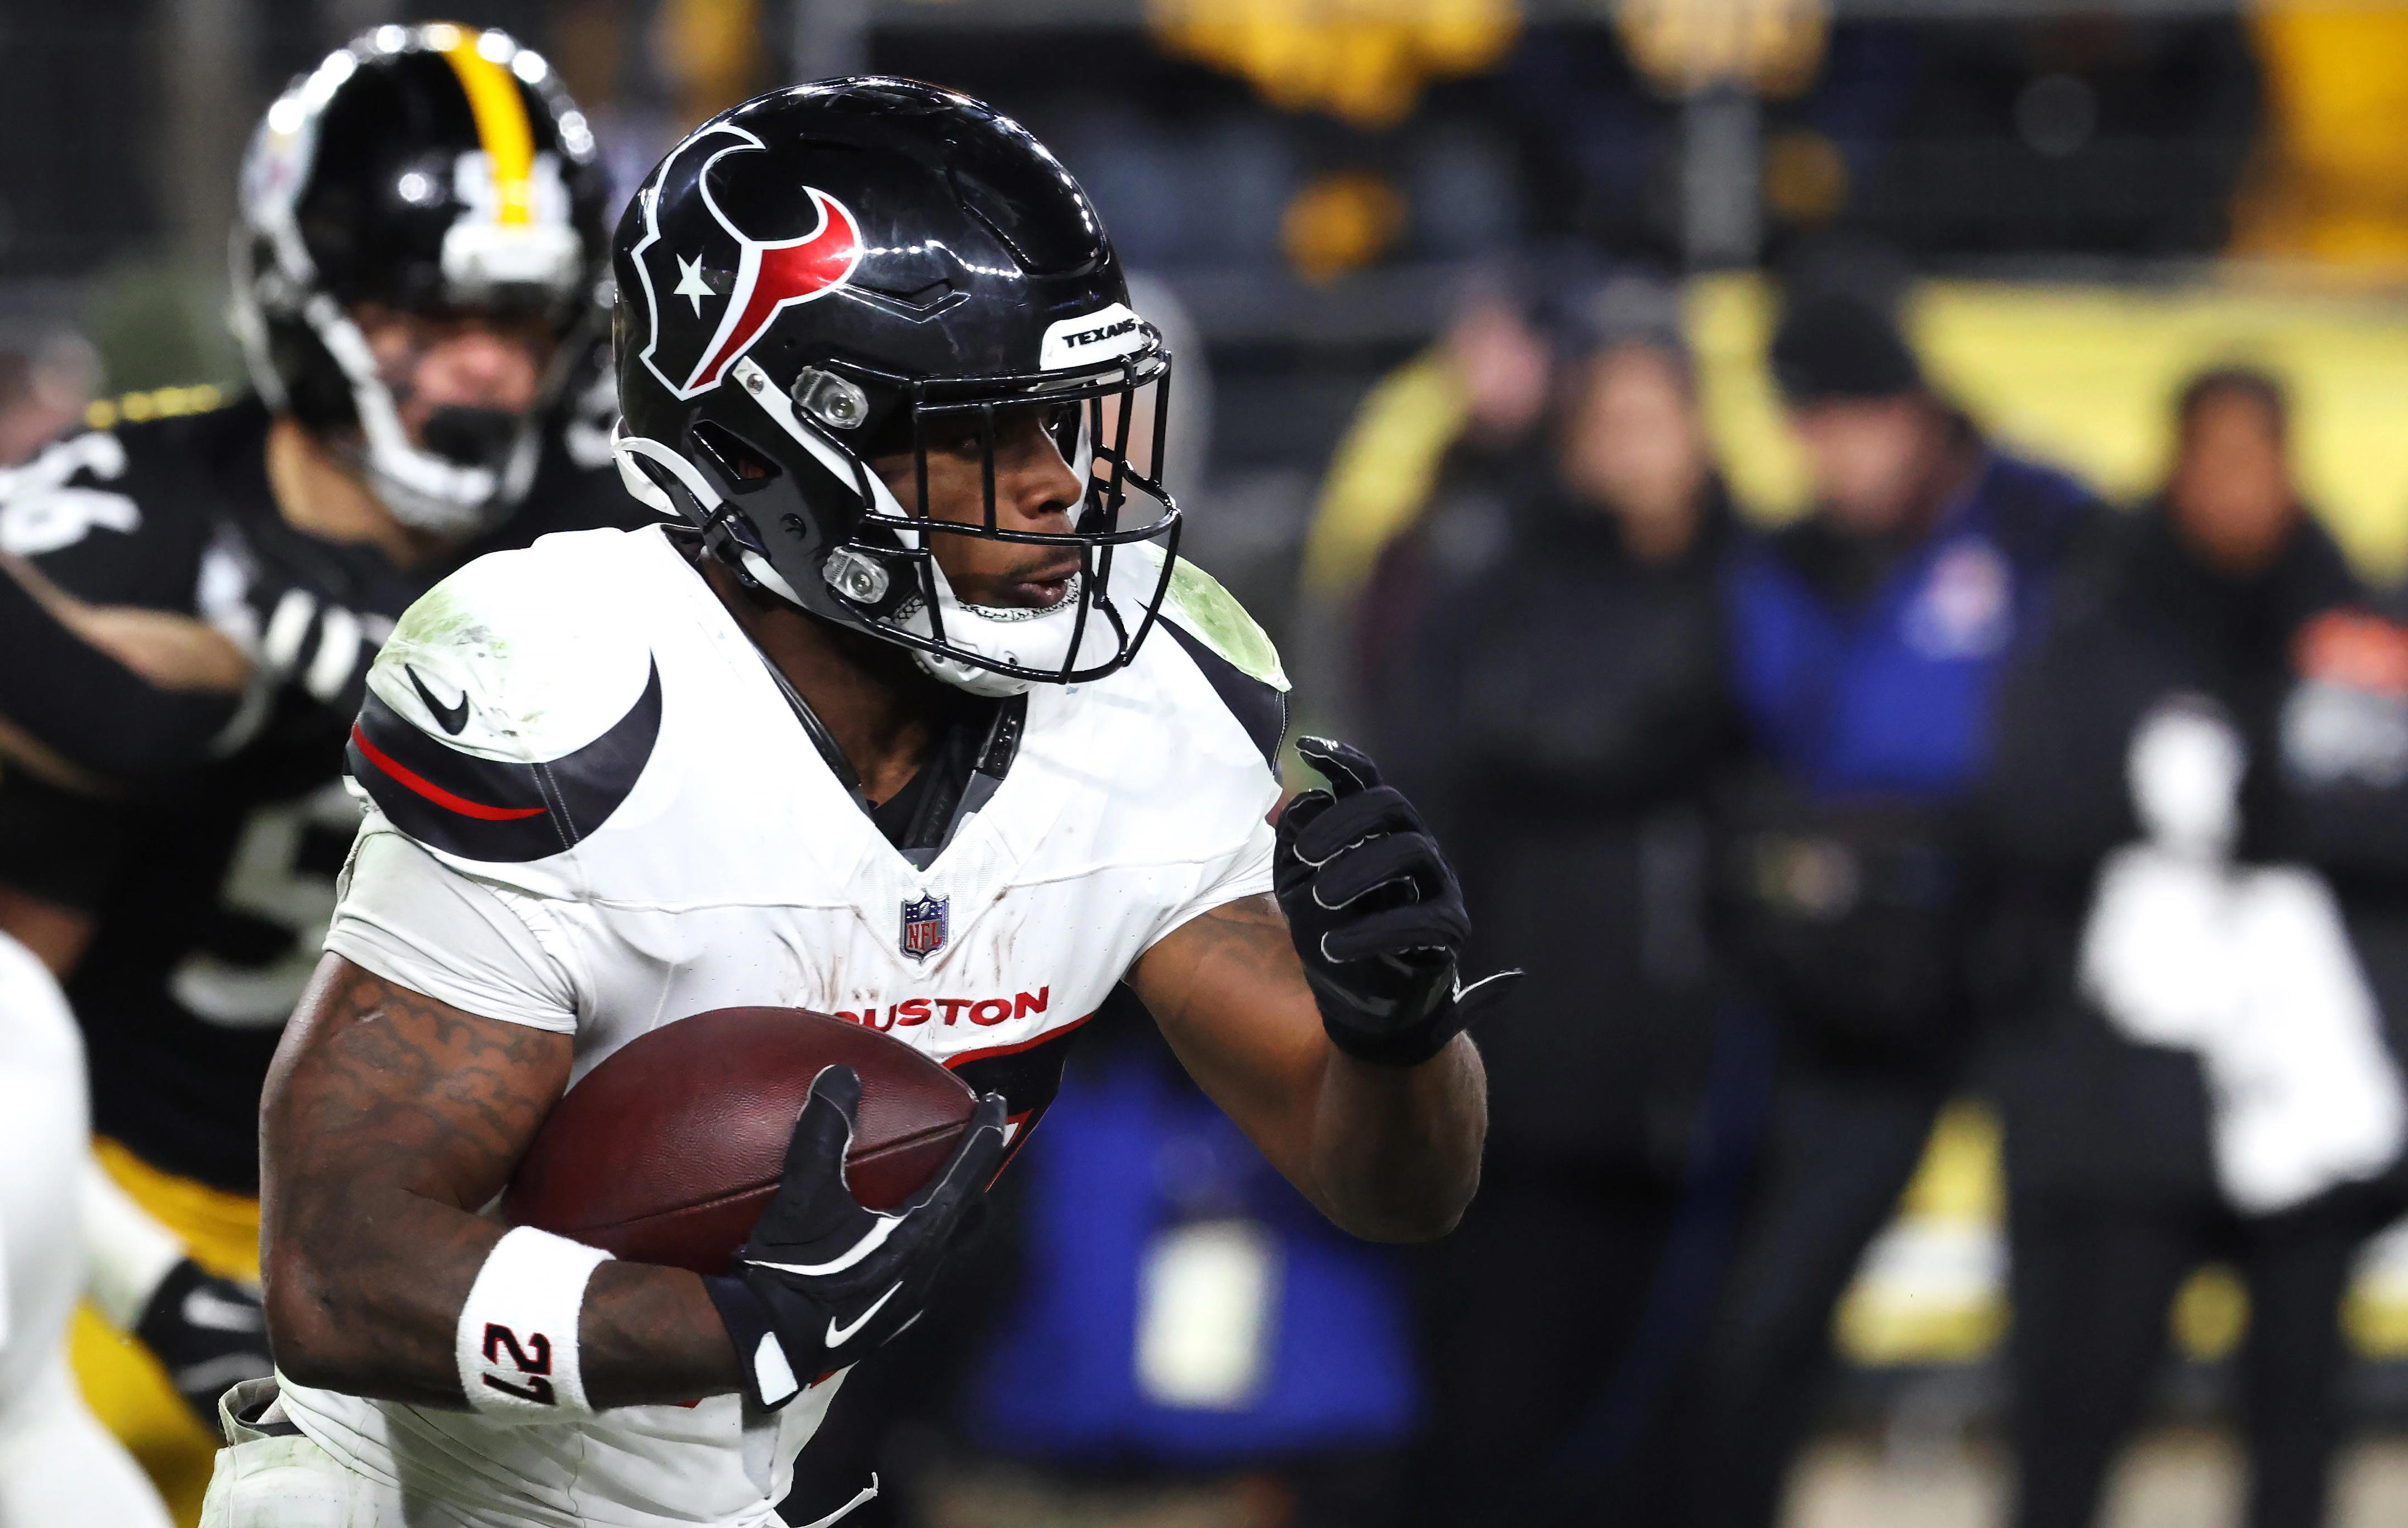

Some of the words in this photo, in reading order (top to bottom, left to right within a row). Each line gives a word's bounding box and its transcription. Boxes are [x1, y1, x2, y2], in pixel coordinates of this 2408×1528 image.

[1062, 318, 1136, 348] TEXANS
[907, 921, 942, 951] NFL
[835, 985, 1050, 1033] USTON
[482, 1322, 556, 1406] 27
